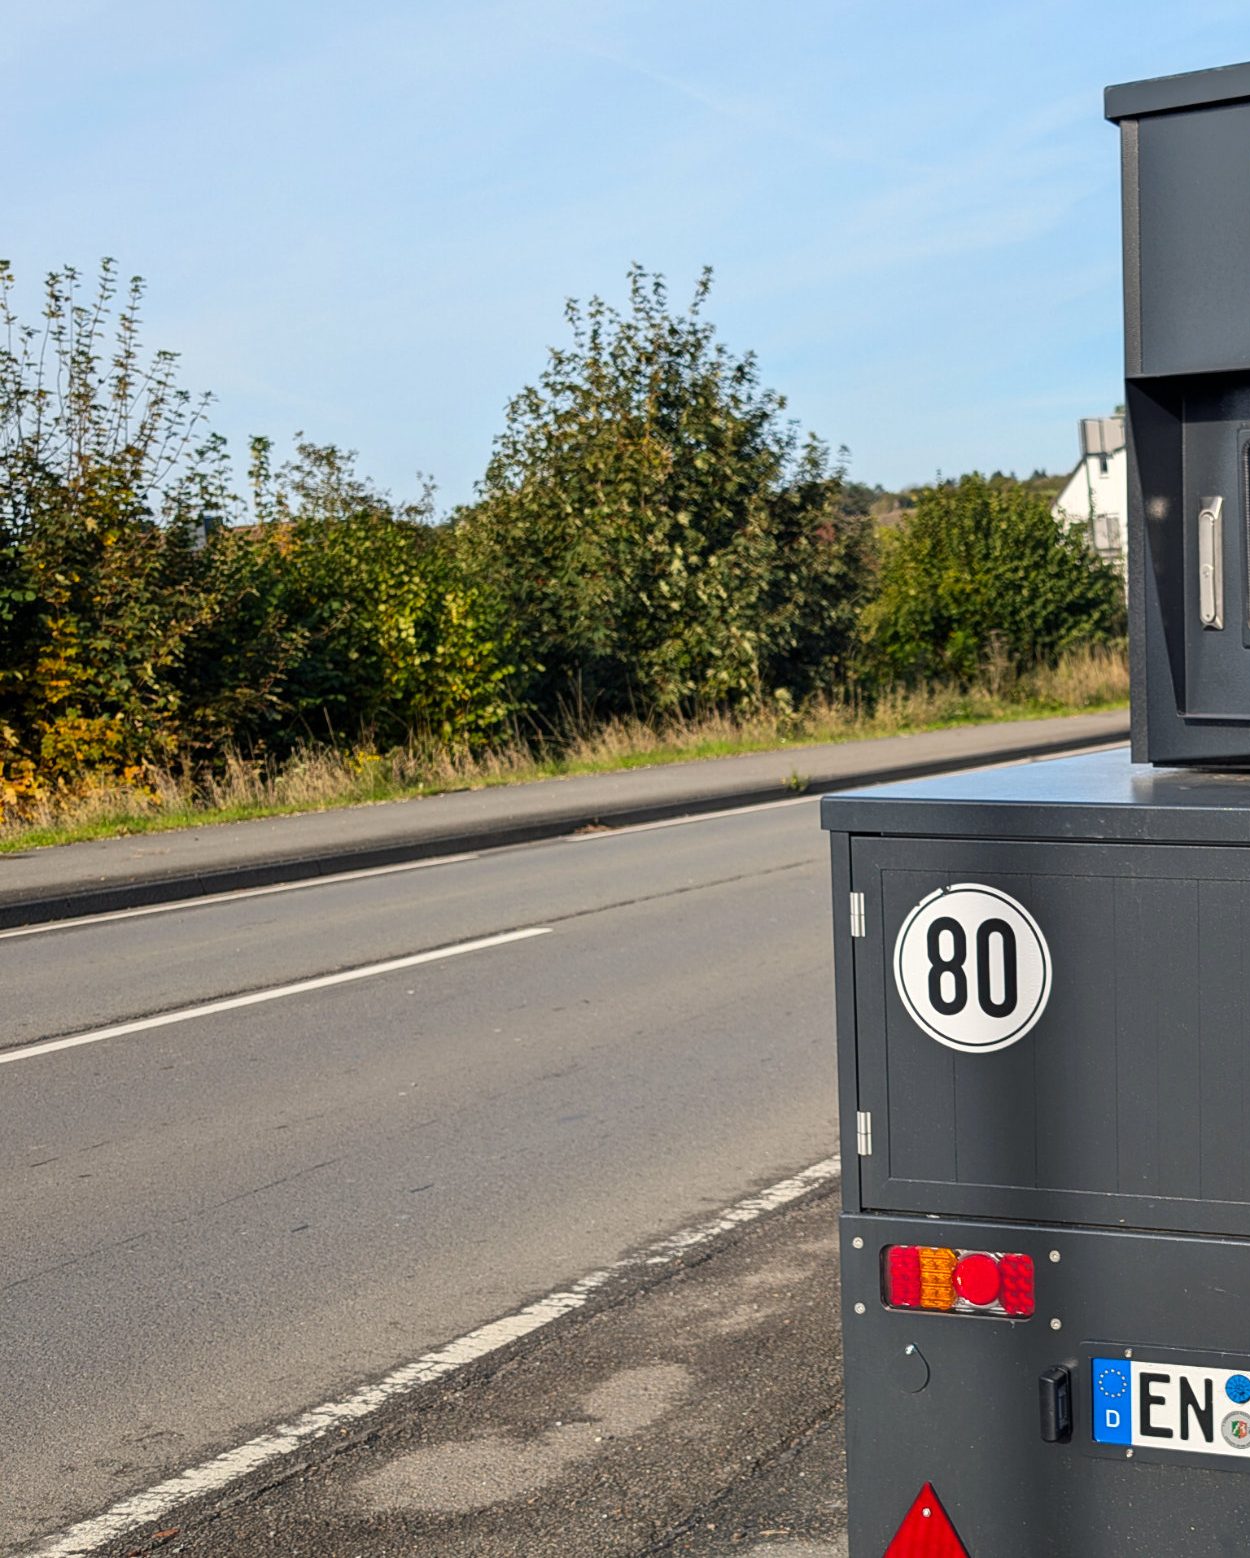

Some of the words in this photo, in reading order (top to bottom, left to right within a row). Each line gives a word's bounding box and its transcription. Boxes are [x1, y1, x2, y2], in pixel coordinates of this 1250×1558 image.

[926, 916, 1018, 1019] 80
[1105, 1409, 1121, 1428] D
[1139, 1372, 1214, 1443] EN
